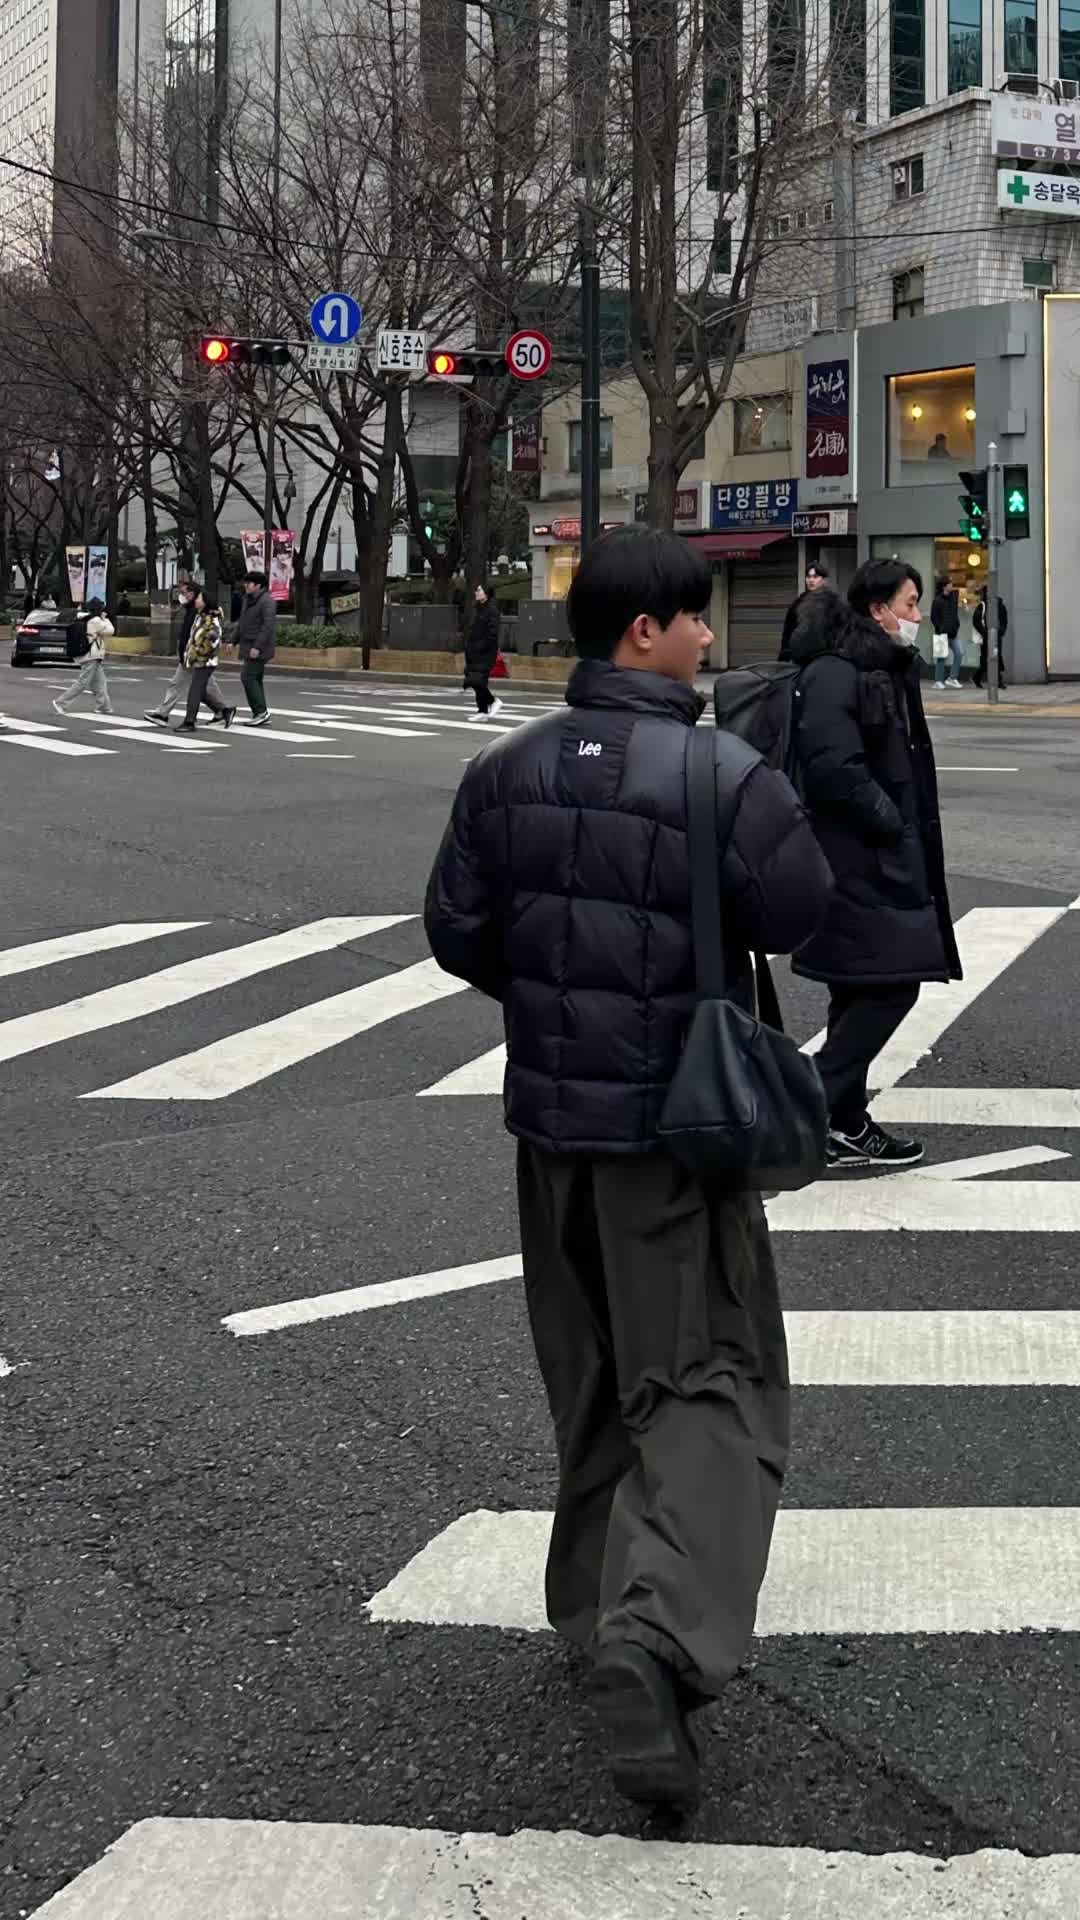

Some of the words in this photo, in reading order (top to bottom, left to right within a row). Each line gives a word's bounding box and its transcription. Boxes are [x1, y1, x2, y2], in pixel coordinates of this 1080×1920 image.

[1055, 113, 1077, 143] 열
[1034, 181, 1080, 205] 송달옥
[379, 334, 423, 366] 신호준수
[515, 343, 542, 368] 50
[718, 482, 791, 511] 단양필방
[578, 740, 602, 757] Lee
